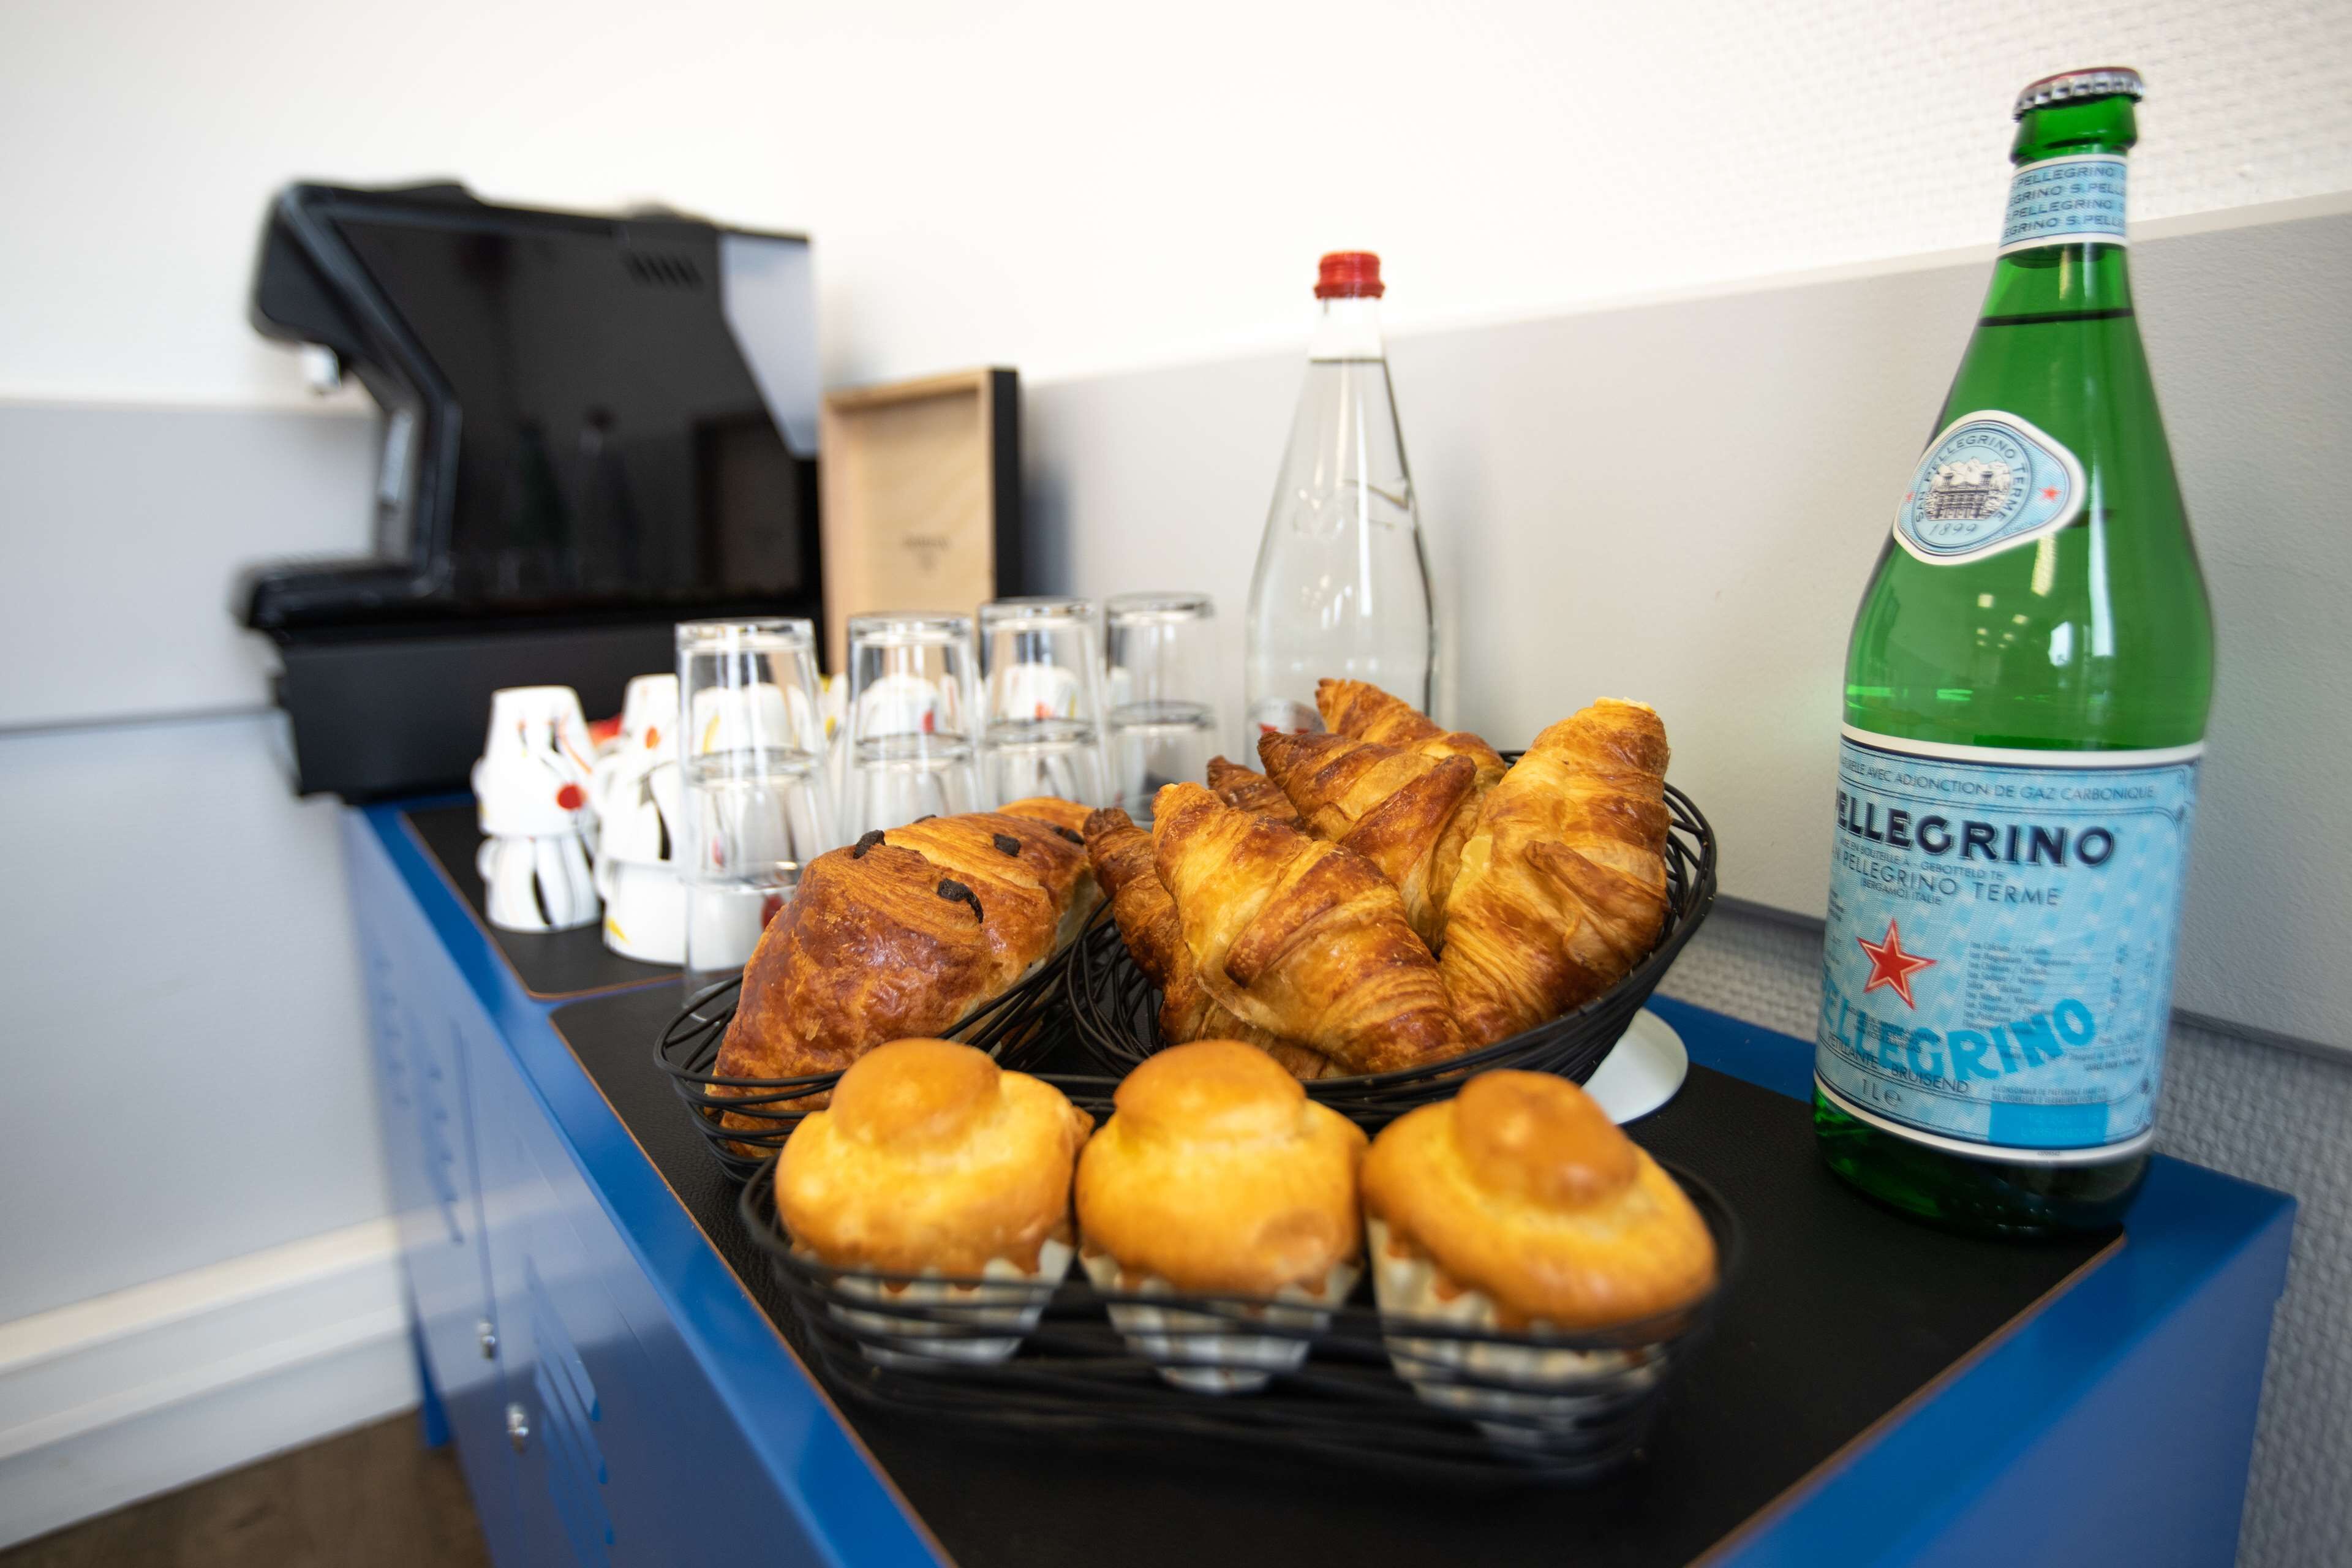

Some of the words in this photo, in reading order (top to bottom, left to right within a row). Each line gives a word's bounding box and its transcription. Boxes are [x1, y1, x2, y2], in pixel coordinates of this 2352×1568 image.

[1924, 434, 2016, 483] PELLEGRINO
[1995, 463, 2026, 521] TERME
[1929, 522, 1977, 536] 1899
[1866, 767, 1891, 782] AVEC
[1894, 774, 1989, 796] ADJONCTION
[1994, 785, 2015, 797] DE
[2019, 786, 2055, 800] GAZ
[2060, 785, 2155, 801] CARBONIQUE
[1836, 788, 2116, 867] ELLEGRINO
[1842, 851, 1958, 895] PELLEGRINO
[1972, 881, 2059, 907] TERME
[1920, 860, 1985, 879] GEBOTTELD
[1990, 869, 2004, 880] TE
[1891, 1064, 1969, 1093] BRUISEND
